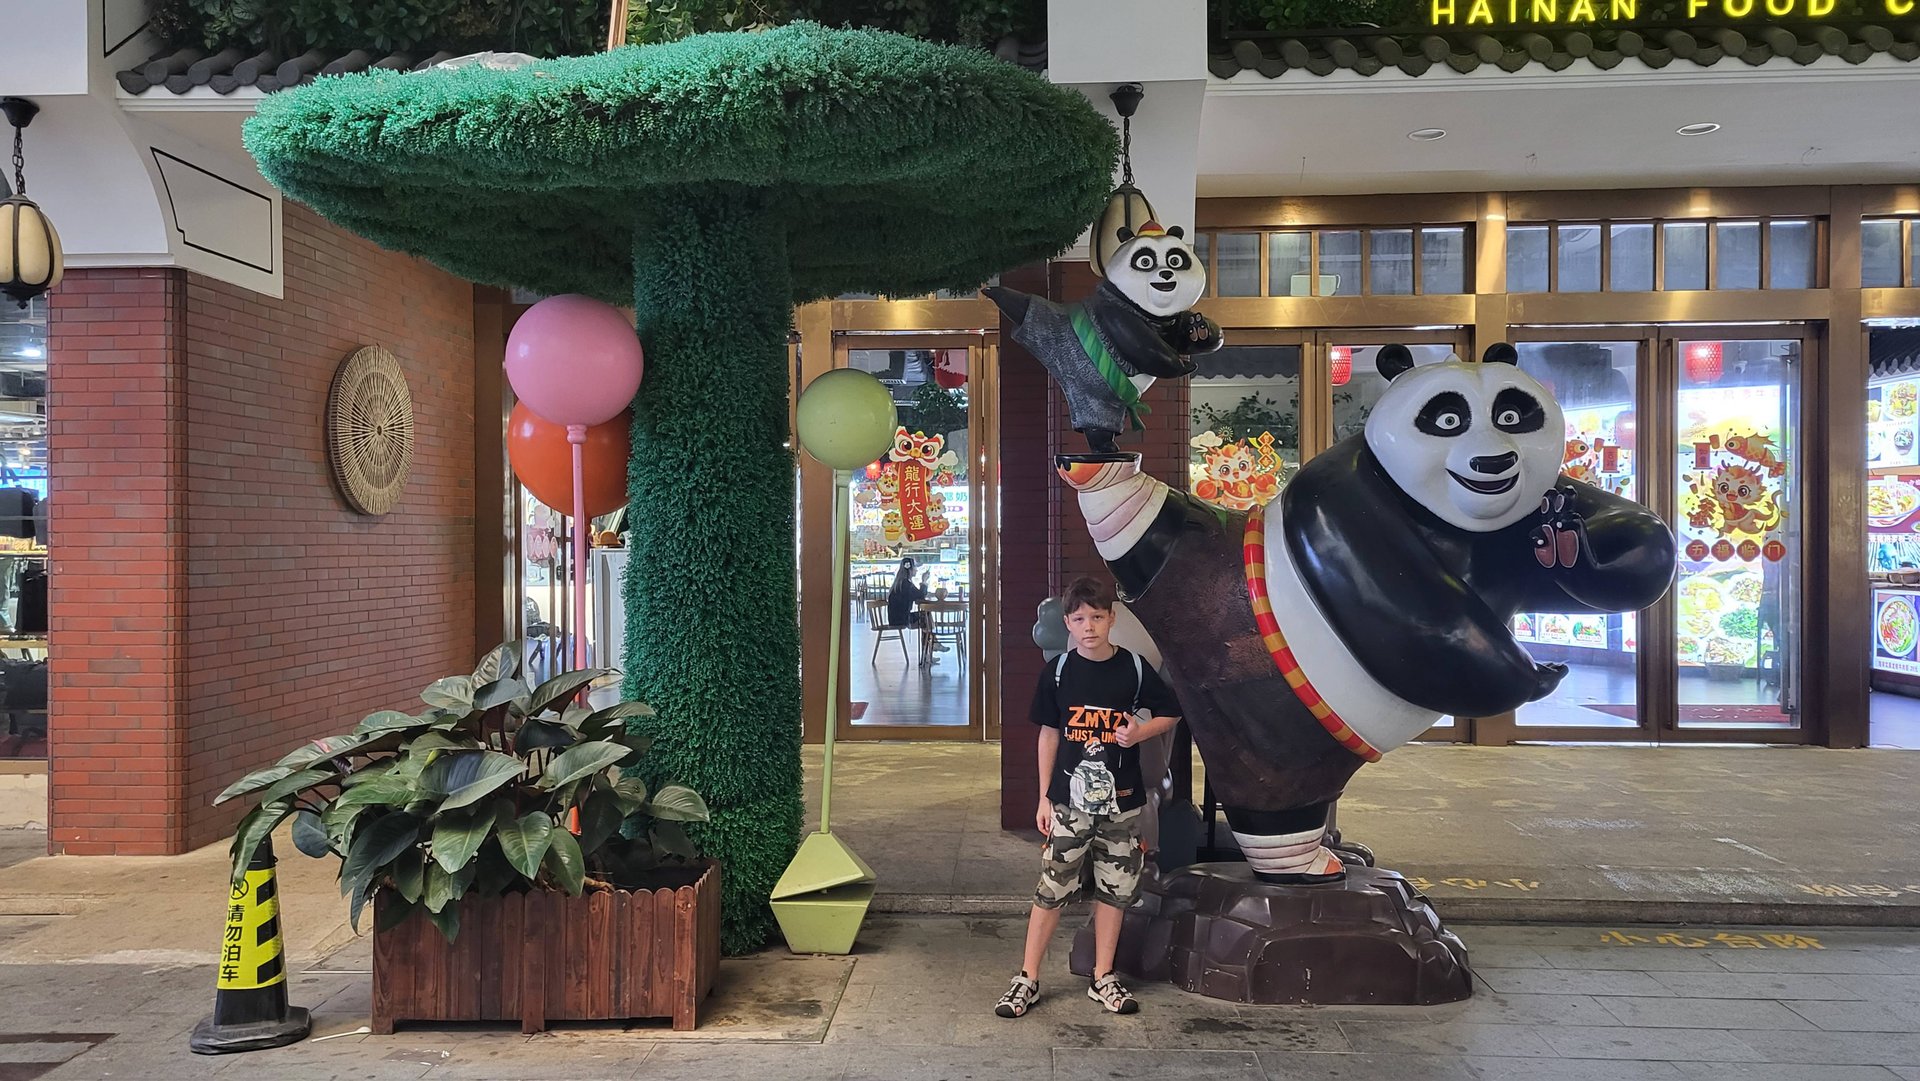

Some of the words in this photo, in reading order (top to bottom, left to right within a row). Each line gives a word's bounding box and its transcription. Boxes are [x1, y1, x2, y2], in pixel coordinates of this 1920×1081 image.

[1431, 0, 1637, 25] HAINAN
[1687, 0, 1836, 18] FOOD
[904, 465, 926, 530] 龍行大運
[1691, 543, 1781, 557] 五福临门
[221, 904, 245, 982] 请勿泊车
[1599, 930, 1827, 950] 小心台阶
